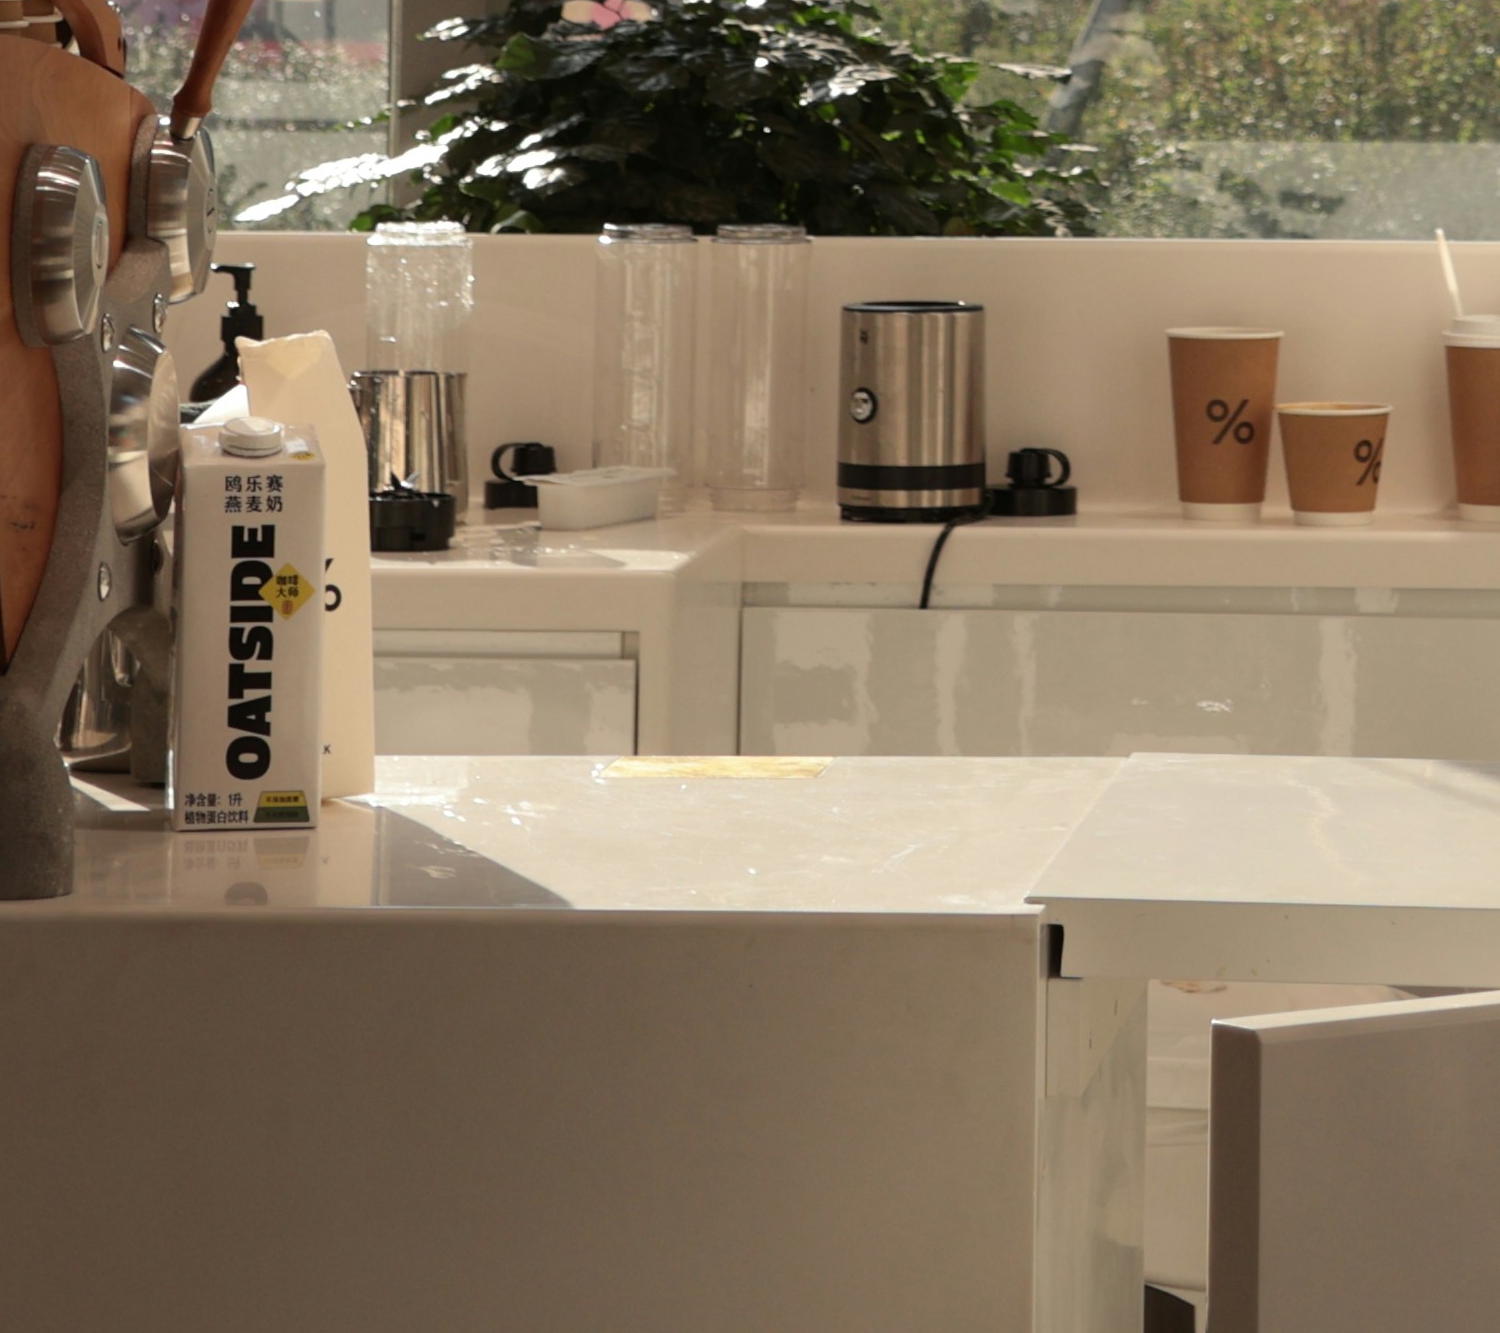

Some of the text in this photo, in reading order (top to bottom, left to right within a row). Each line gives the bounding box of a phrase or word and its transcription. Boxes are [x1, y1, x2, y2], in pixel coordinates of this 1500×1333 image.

[1206, 399, 1256, 446] %
[224, 495, 284, 513] 燕麦奶
[226, 524, 276, 781] OATSIDE
